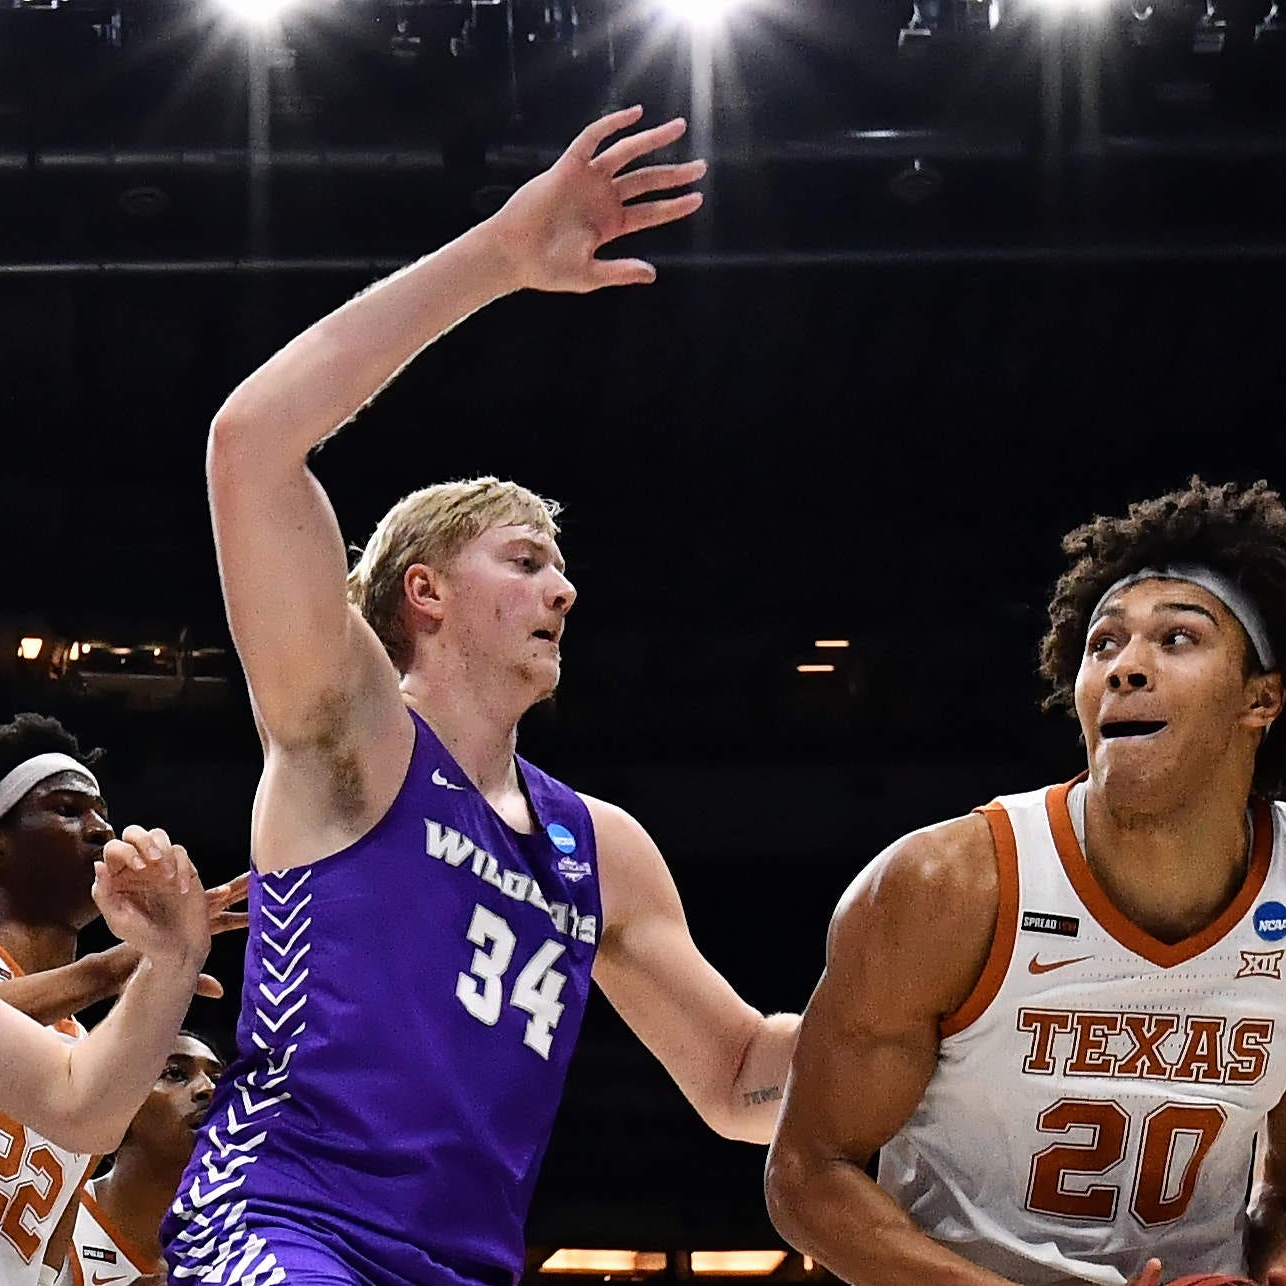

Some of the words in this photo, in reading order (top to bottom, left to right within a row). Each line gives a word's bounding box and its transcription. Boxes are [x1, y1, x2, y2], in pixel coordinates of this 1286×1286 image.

[456, 903, 567, 1061] 34
[1017, 1007, 1275, 1086] TEXAS
[1024, 1098, 1228, 1229] 20
